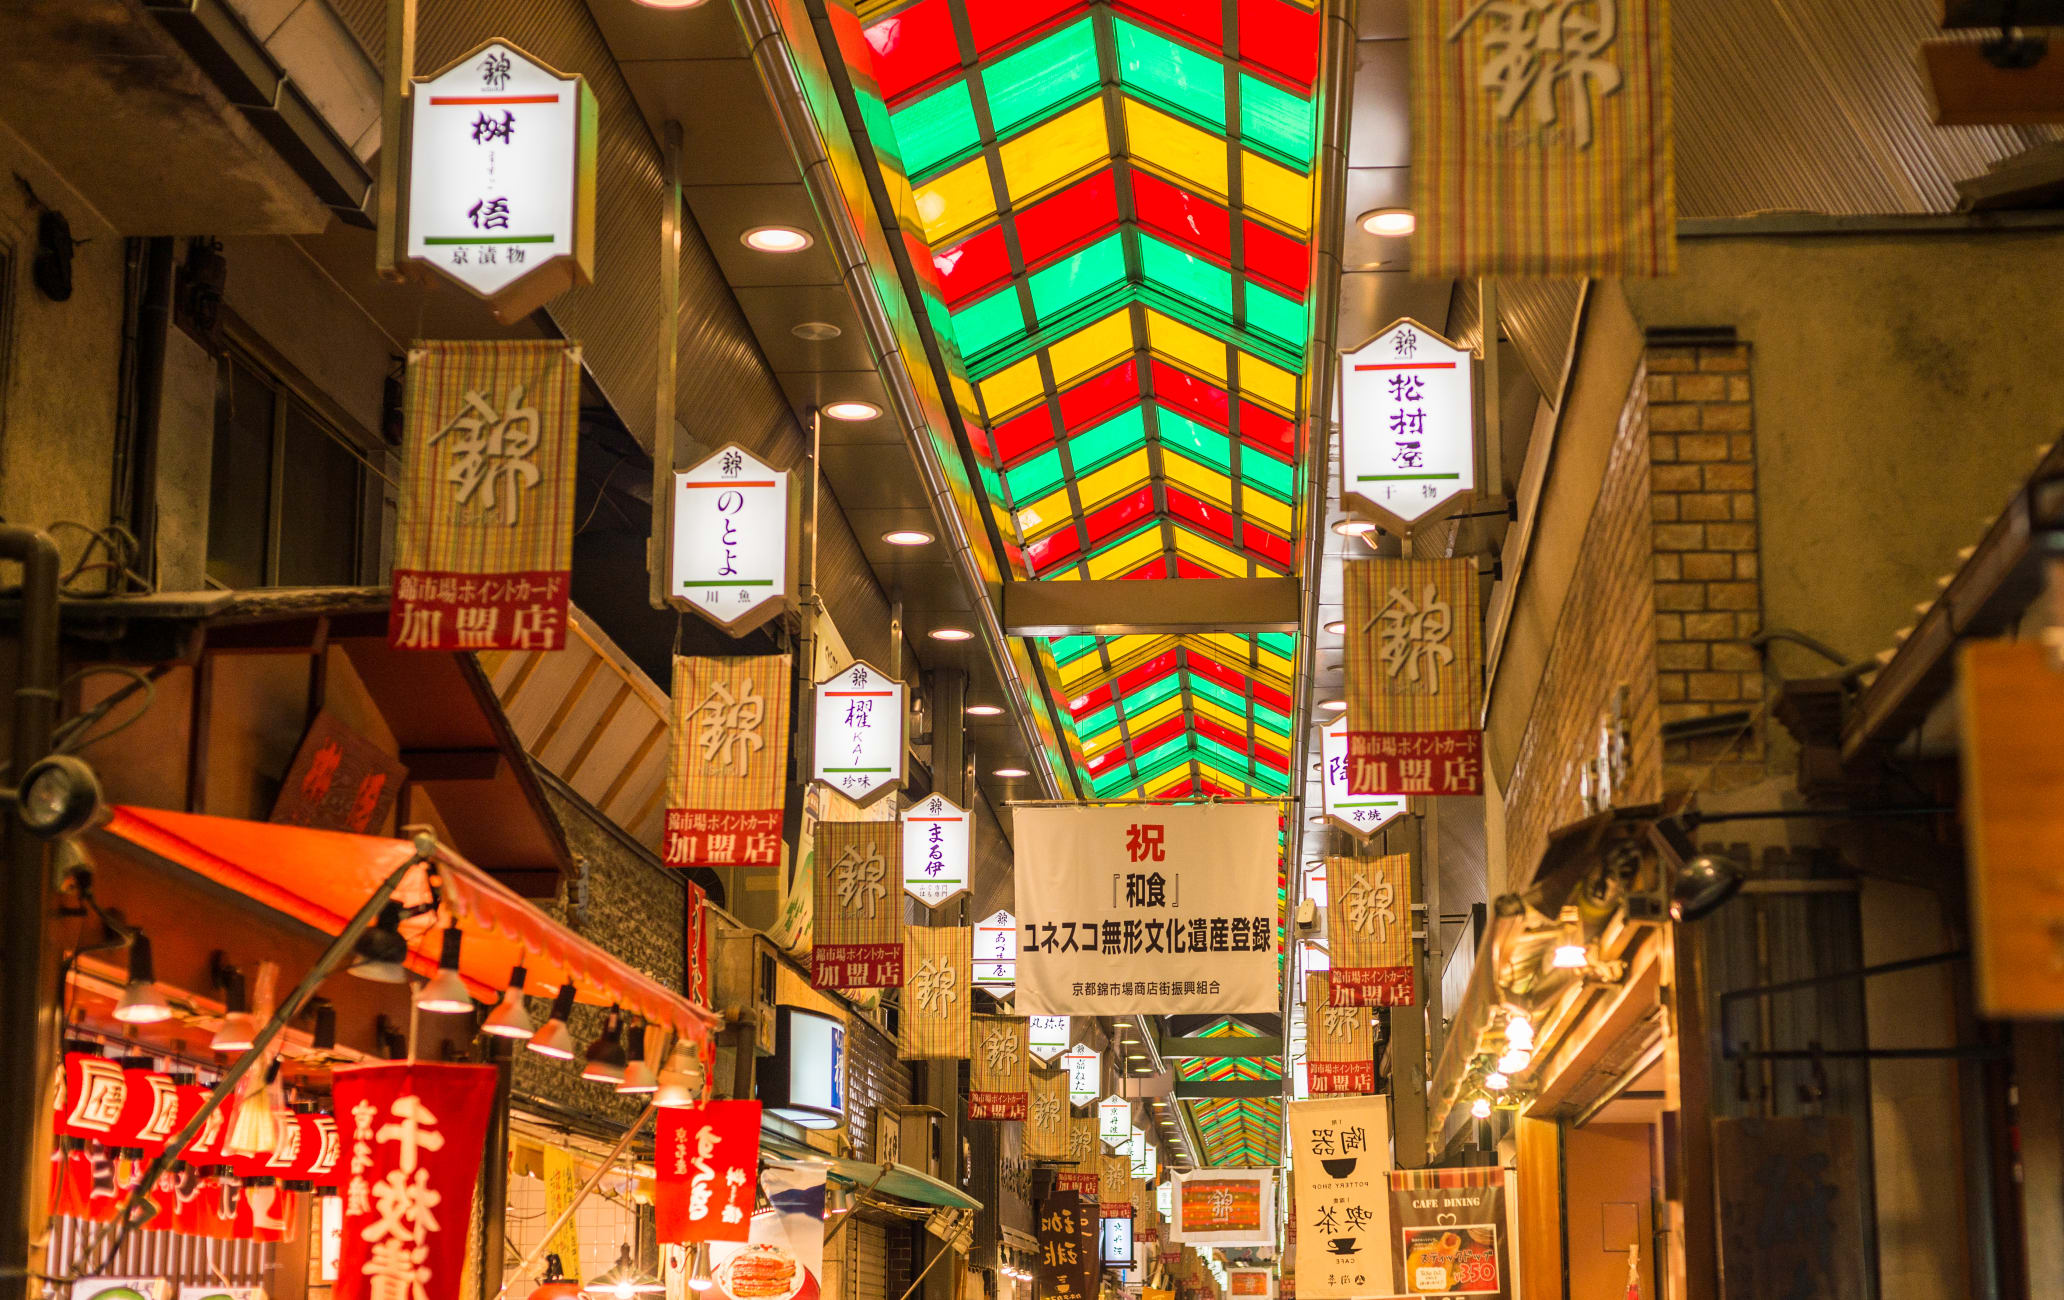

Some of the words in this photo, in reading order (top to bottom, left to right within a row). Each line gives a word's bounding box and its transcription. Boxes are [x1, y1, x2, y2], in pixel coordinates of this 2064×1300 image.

[476, 51, 511, 91] 錦
[1447, 0, 1624, 151] 錦
[450, 245, 526, 265] 京漬物
[1389, 329, 1417, 360] 錦
[1388, 373, 1427, 469] 松村屋
[427, 384, 545, 528] 錦
[717, 450, 743, 479] 錦
[716, 490, 744, 576] のとよ
[397, 577, 563, 604] 錦市場ポイントカード
[705, 589, 752, 604] 川魚
[394, 604, 559, 650] 加盟店
[1363, 582, 1456, 696] 錦
[848, 667, 868, 689] 錦
[685, 676, 766, 779] 錦
[852, 731, 863, 766] KAI
[1351, 735, 1478, 756] 錦市場ポイントカード
[842, 774, 871, 789] 珍味
[1352, 756, 1479, 793] 加盟店
[667, 811, 779, 833] 錦市場ポイントカード
[926, 797, 942, 816] 錦
[1352, 809, 1382, 822] 京焼
[665, 832, 778, 865] 加盟店
[924, 823, 945, 878] まる伊
[1126, 823, 1166, 862] 祝
[826, 841, 887, 920] 錦
[1113, 872, 1179, 908] 『和食』
[1337, 870, 1397, 944] 錦
[1023, 917, 1271, 955] ユネスコ無形文化遺産登録
[815, 947, 901, 962] 錦市場ポイントカード
[815, 962, 901, 987] 加盟店
[907, 955, 957, 1020] 錦
[1072, 980, 1221, 997] 京都錦市場商店街振興組合
[1332, 969, 1411, 985] 錦市場ポイントカード
[1332, 984, 1413, 1006] 加盟店
[979, 1025, 1019, 1077] 錦
[1309, 1062, 1371, 1075] 錦市場ポイントカード
[1310, 1074, 1373, 1092] 加盟店
[971, 1103, 1026, 1120] 加盟店
[1028, 1091, 1062, 1134] 錦
[1208, 1188, 1234, 1224] 錦
[1412, 1198, 1438, 1209] CAFE
[1444, 1197, 1480, 1207] DINING
